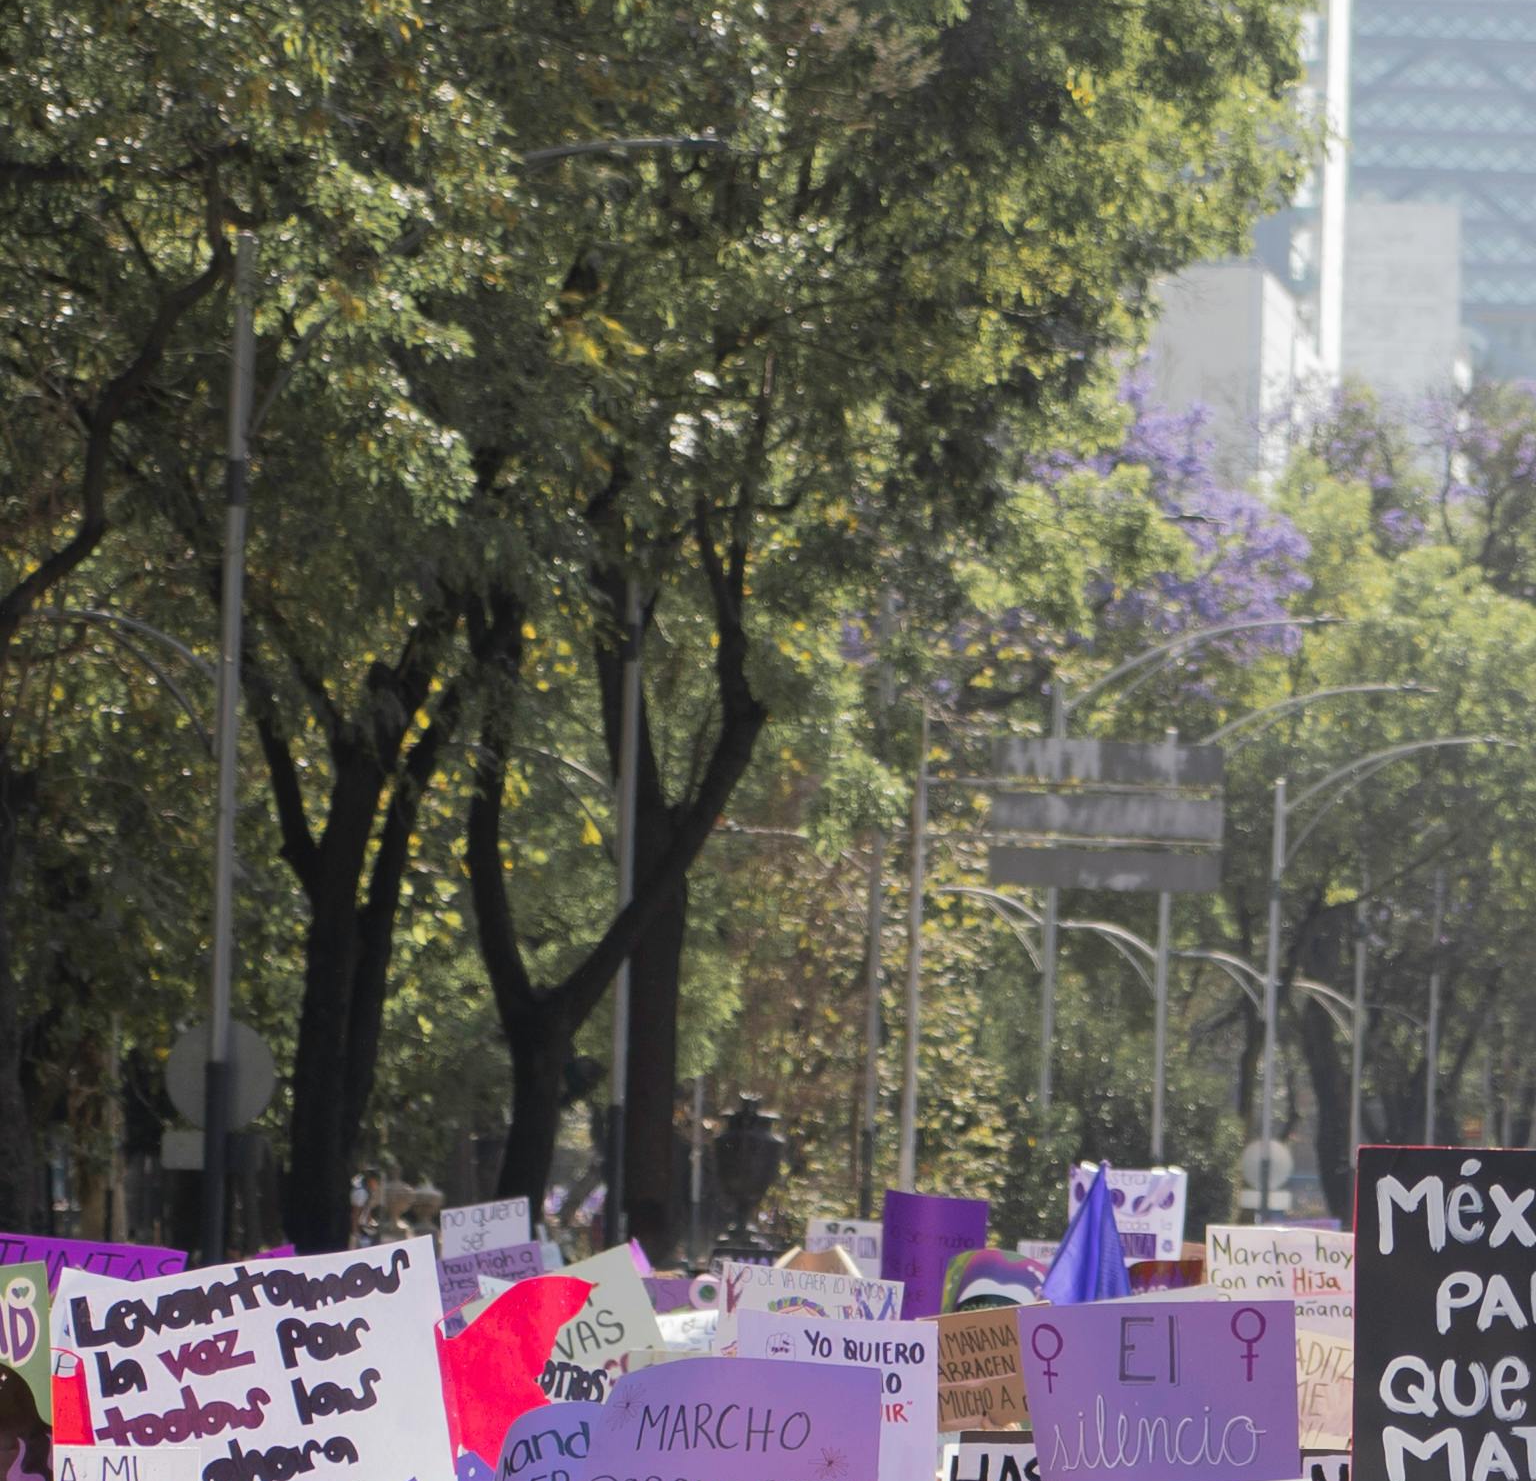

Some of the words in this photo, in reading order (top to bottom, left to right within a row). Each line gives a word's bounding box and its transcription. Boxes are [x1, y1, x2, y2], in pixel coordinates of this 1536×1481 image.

[1212, 1233, 1302, 1266] Marcho
[804, 1329, 832, 1358] YO
[636, 1403, 812, 1453] MARCHO
[1050, 1395, 1266, 1471] silencio
